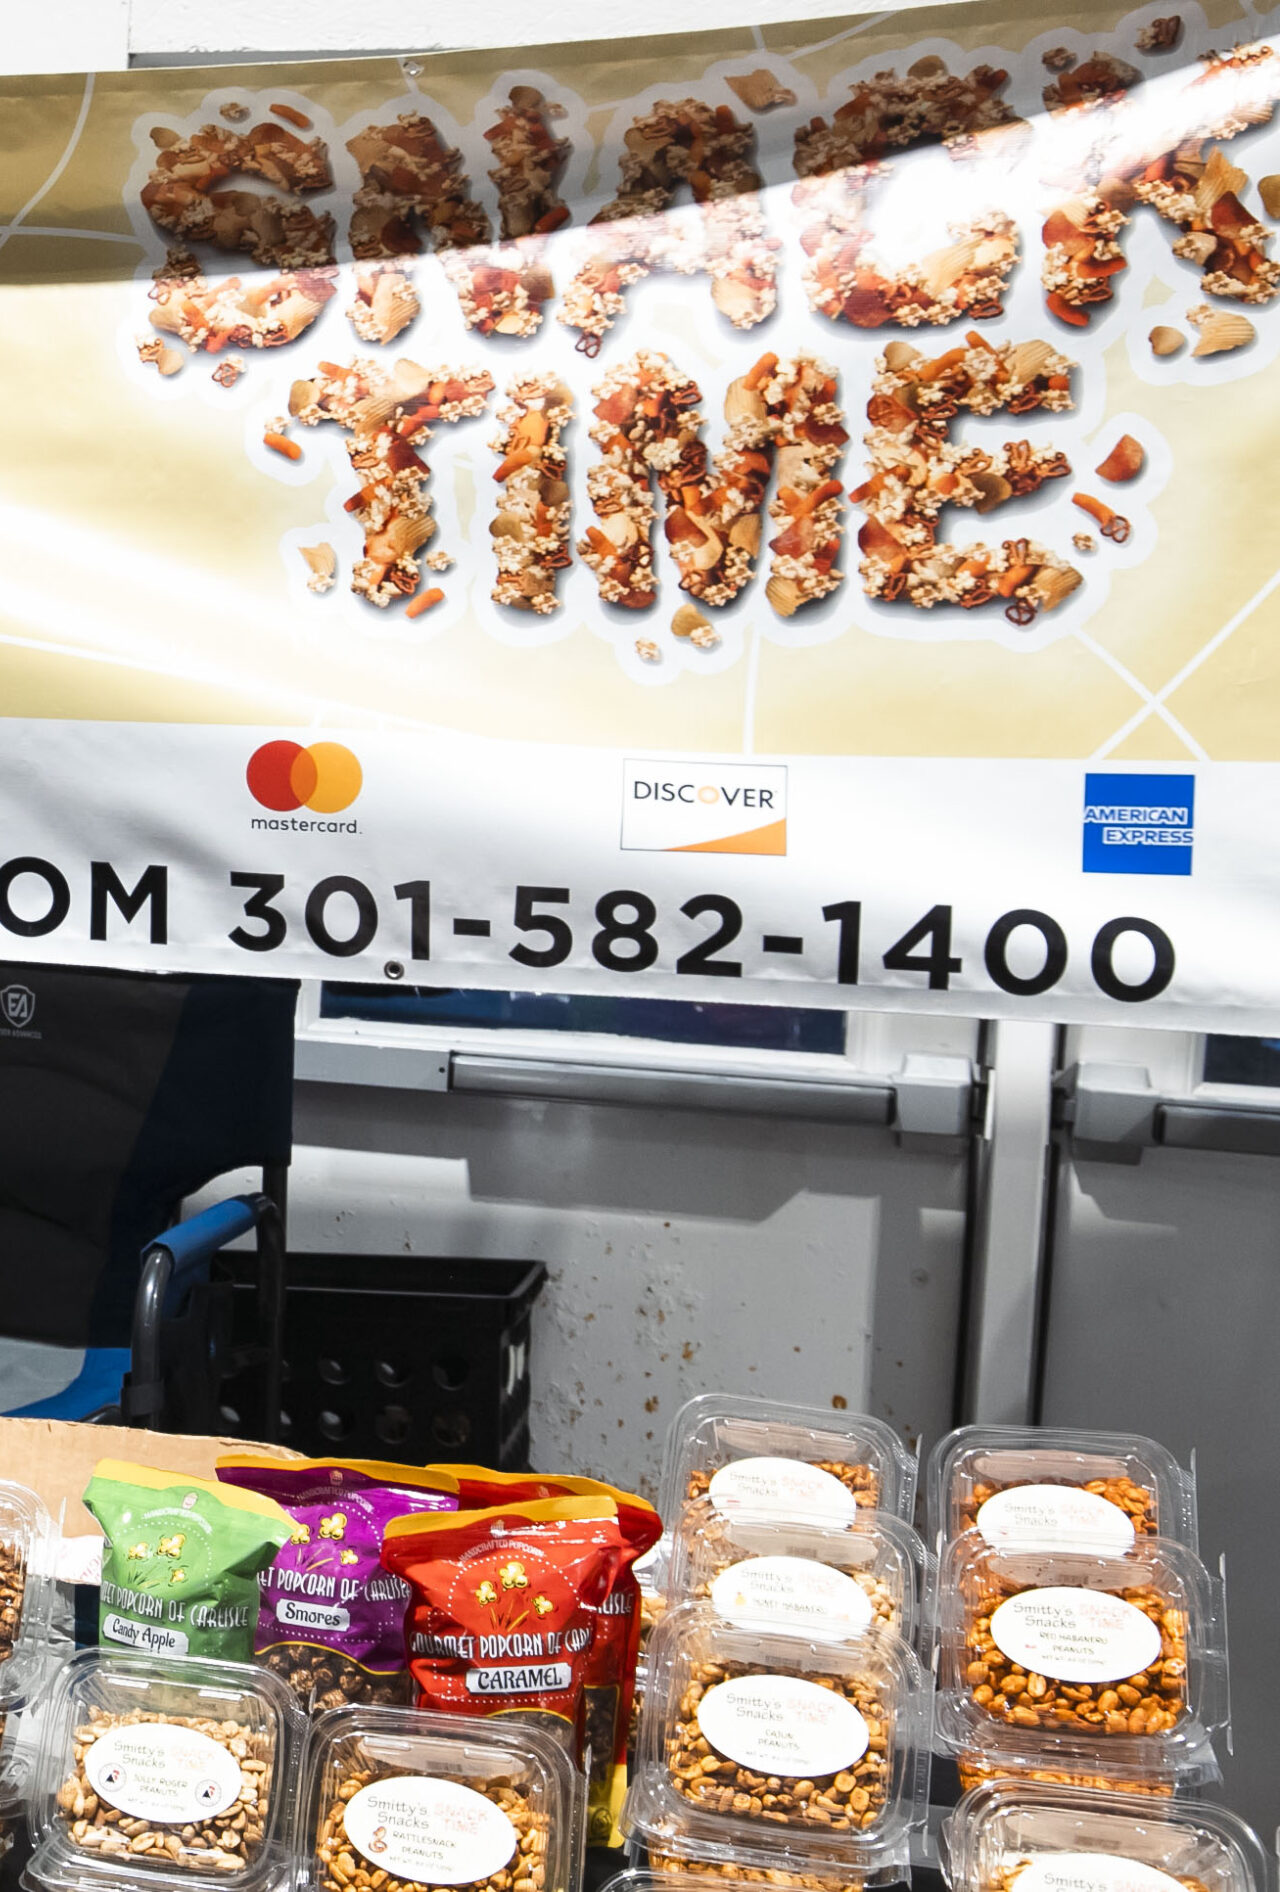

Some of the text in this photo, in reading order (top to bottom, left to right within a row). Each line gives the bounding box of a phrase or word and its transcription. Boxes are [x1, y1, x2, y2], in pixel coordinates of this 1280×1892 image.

[139, 38, 1280, 355] SNACK
[288, 332, 1082, 617] TIME
[634, 781, 774, 809] DISCOVER
[1083, 807, 1187, 823] AMERICAN
[1104, 828, 1194, 844] EXPRESS
[228, 871, 1176, 1003] 301-582-1400
[729, 1471, 777, 1486] Smitty's
[737, 1483, 778, 1497] Snacks
[1004, 1502, 1056, 1516] Smitty's
[1014, 1513, 1059, 1528] Snacks
[740, 1566, 793, 1584] Smitty's
[276, 1567, 336, 1598] POPCORN
[340, 1577, 360, 1601] OF
[749, 1580, 795, 1594] Snacks
[117, 1585, 249, 1628] POPCORN OF CARLISLE
[284, 1601, 341, 1627] Smores
[1013, 1601, 1074, 1618] Smitty's
[1024, 1615, 1077, 1629] Snacks
[112, 1617, 176, 1650] Candy Apple
[1039, 1630, 1057, 1640] RED
[409, 1634, 474, 1659] GOURMET
[479, 1632, 543, 1659] POPCORN
[546, 1631, 561, 1655] OF
[1051, 1644, 1096, 1656] PEANUTS
[477, 1667, 563, 1690] CARAMEL
[726, 1692, 782, 1710] Smitty's
[736, 1706, 784, 1723] Snacks
[765, 1728, 794, 1740] CAJUN
[114, 1740, 165, 1757] Smitty's
[757, 1737, 801, 1751] PEANUTS
[122, 1753, 167, 1769] Snacks
[139, 1784, 179, 1797] PEANUTS
[367, 1795, 428, 1817] Smitty's
[377, 1811, 430, 1830] Snacks
[401, 1846, 444, 1861] PEANUTS
